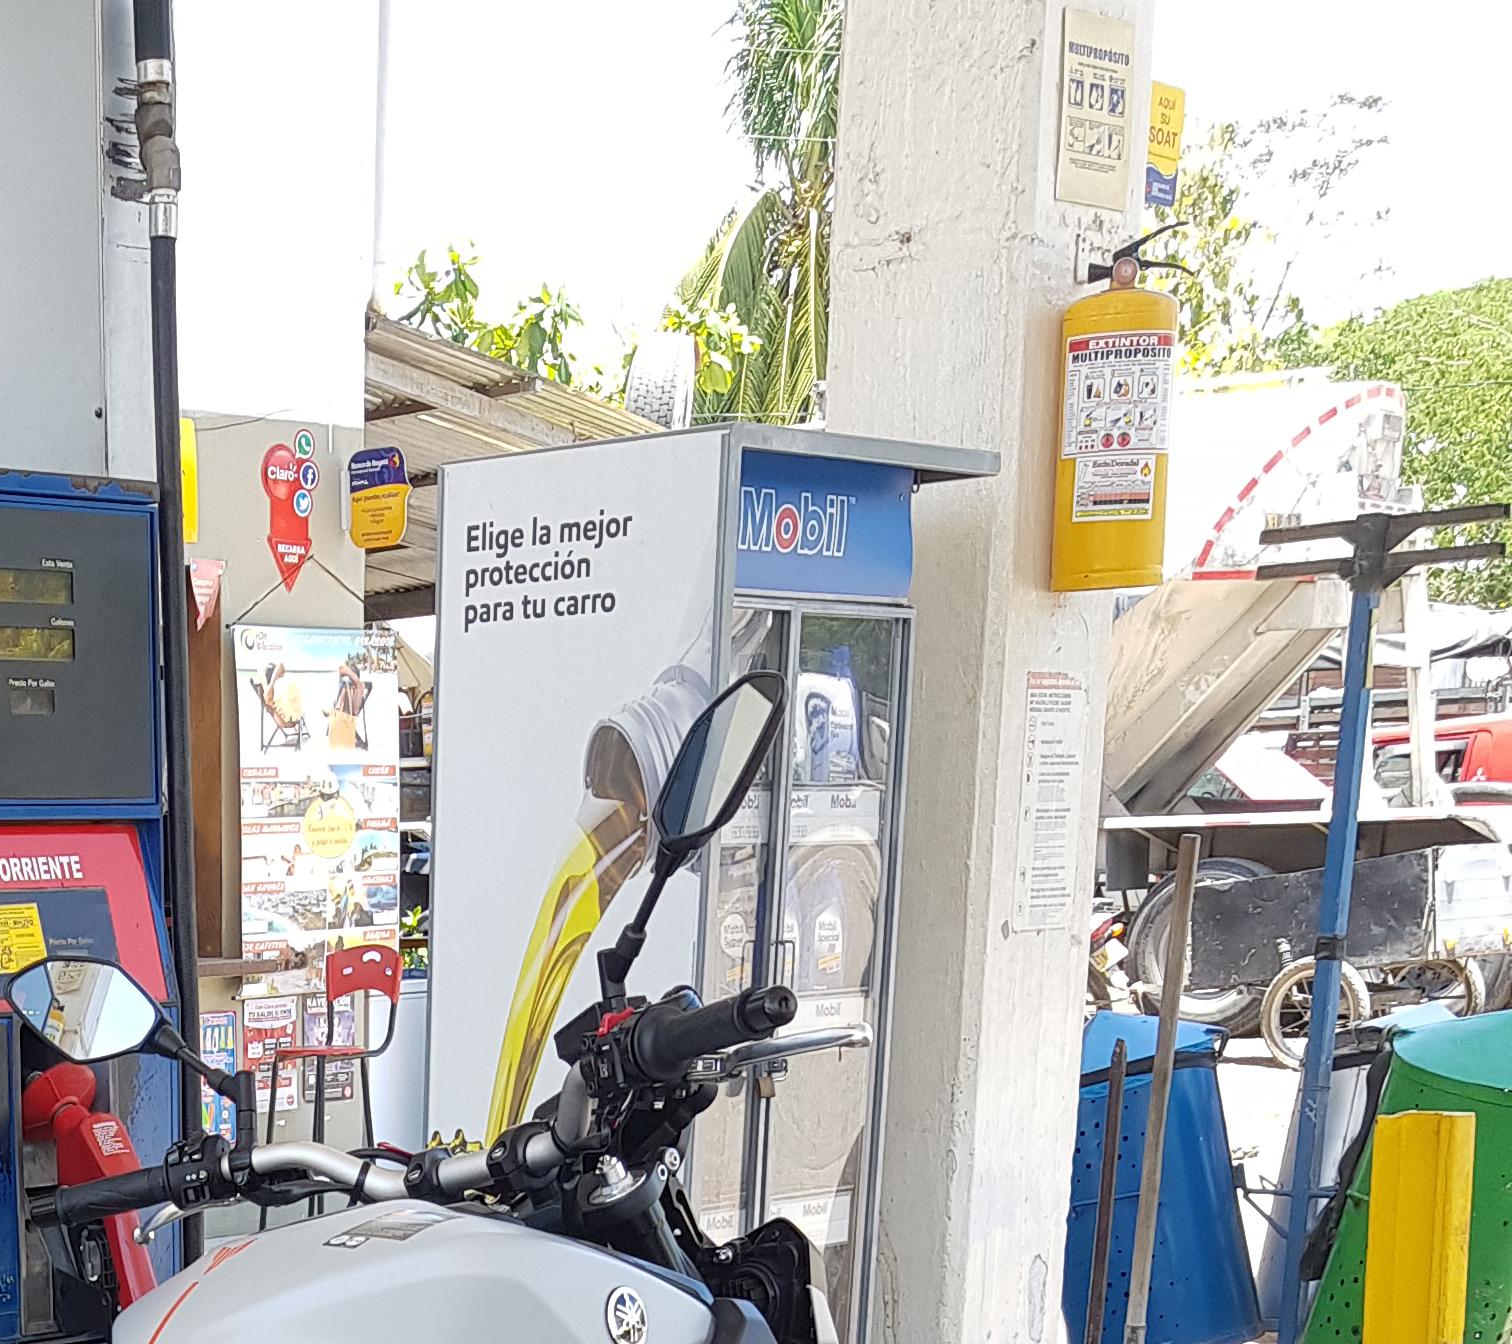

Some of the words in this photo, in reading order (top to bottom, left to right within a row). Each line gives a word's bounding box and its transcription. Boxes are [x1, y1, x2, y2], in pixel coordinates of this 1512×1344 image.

[1160, 112, 1170, 125] SU
[1149, 127, 1178, 149] SOAT
[1088, 335, 1158, 349] EXTINTOR
[268, 465, 296, 481] Claro
[466, 521, 524, 558] Elige
[532, 516, 551, 546] la
[559, 509, 633, 549] mejor
[738, 487, 848, 557] Mobil
[465, 550, 591, 597] protección
[464, 601, 514, 633] para
[522, 595, 545, 619] tu
[554, 592, 616, 616] carro
